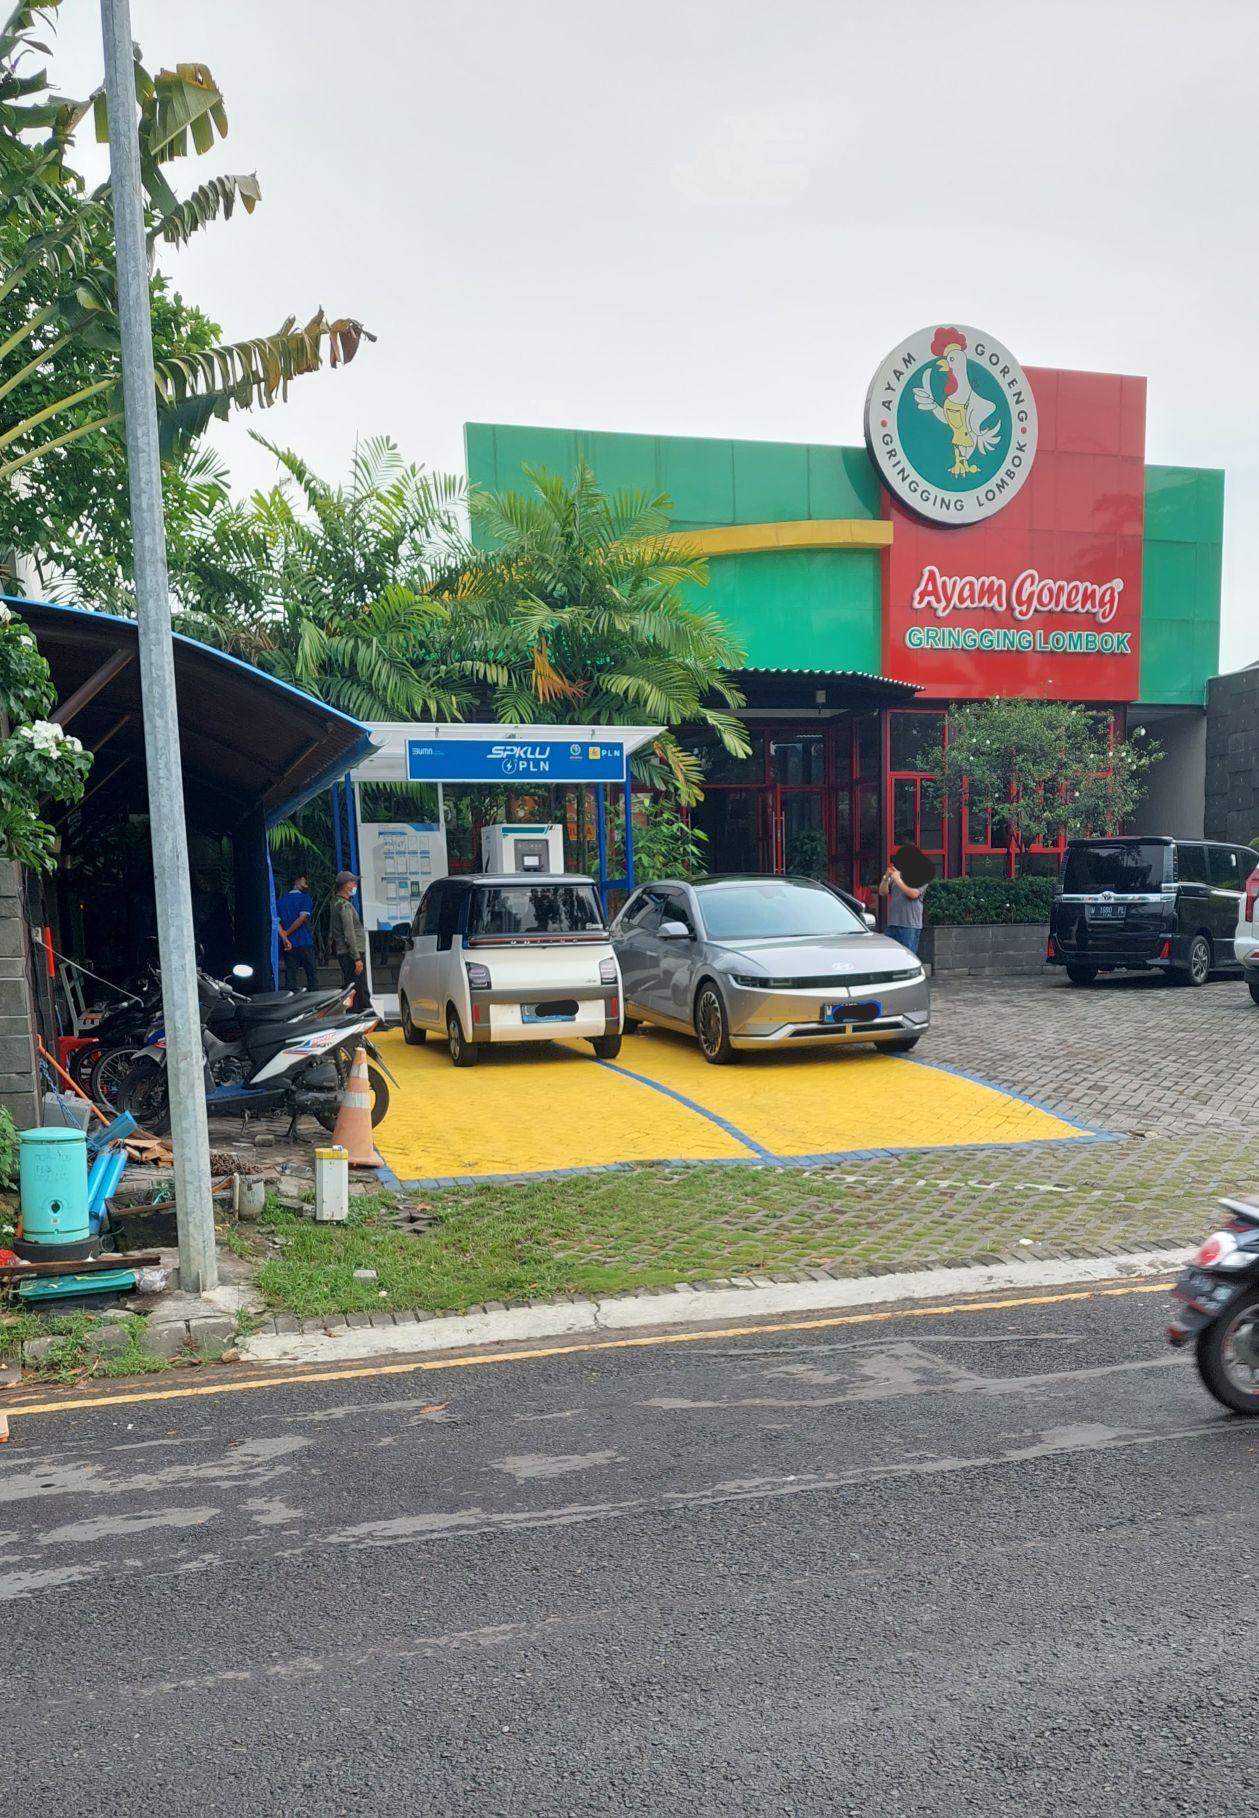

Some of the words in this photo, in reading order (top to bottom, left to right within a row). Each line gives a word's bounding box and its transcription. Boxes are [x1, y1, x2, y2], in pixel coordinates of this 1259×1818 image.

[881, 352, 916, 411] AYAM
[974, 343, 1028, 422] GORENG
[881, 433, 965, 512] GRINGGING
[975, 441, 1027, 507] LOMBOK
[912, 566, 1006, 617] Ayam
[907, 627, 1032, 651] GRINGGING
[1037, 631, 1131, 653] LOMBOK
[486, 746, 550, 758] SPKLU
[601, 749, 620, 757] PLN
[519, 760, 549, 772] PLN
